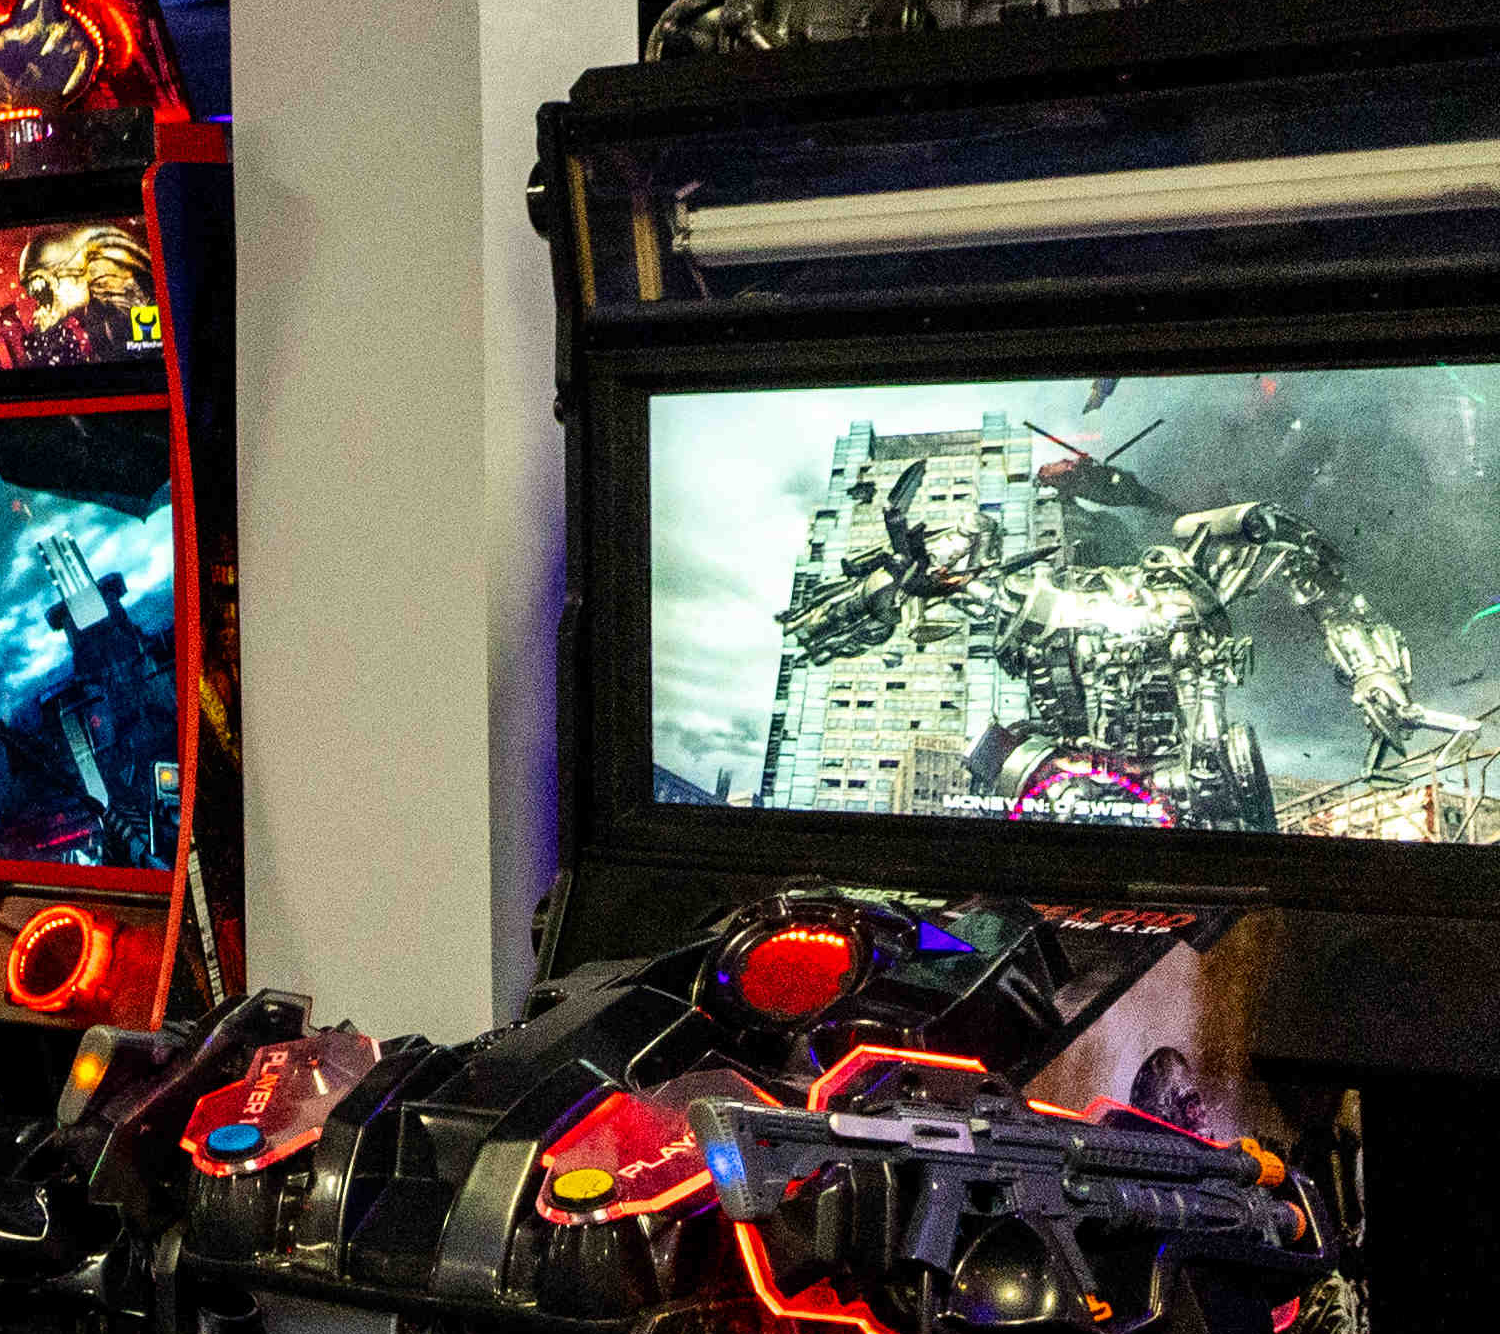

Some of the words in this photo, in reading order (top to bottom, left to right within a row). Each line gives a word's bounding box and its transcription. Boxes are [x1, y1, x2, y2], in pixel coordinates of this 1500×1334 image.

[942, 794, 1016, 812] MONEY
[1022, 798, 1050, 813] IN:
[1074, 800, 1163, 817] SWIPES
[242, 1050, 289, 1115] PLAYER
[618, 1131, 696, 1179] PLAY
